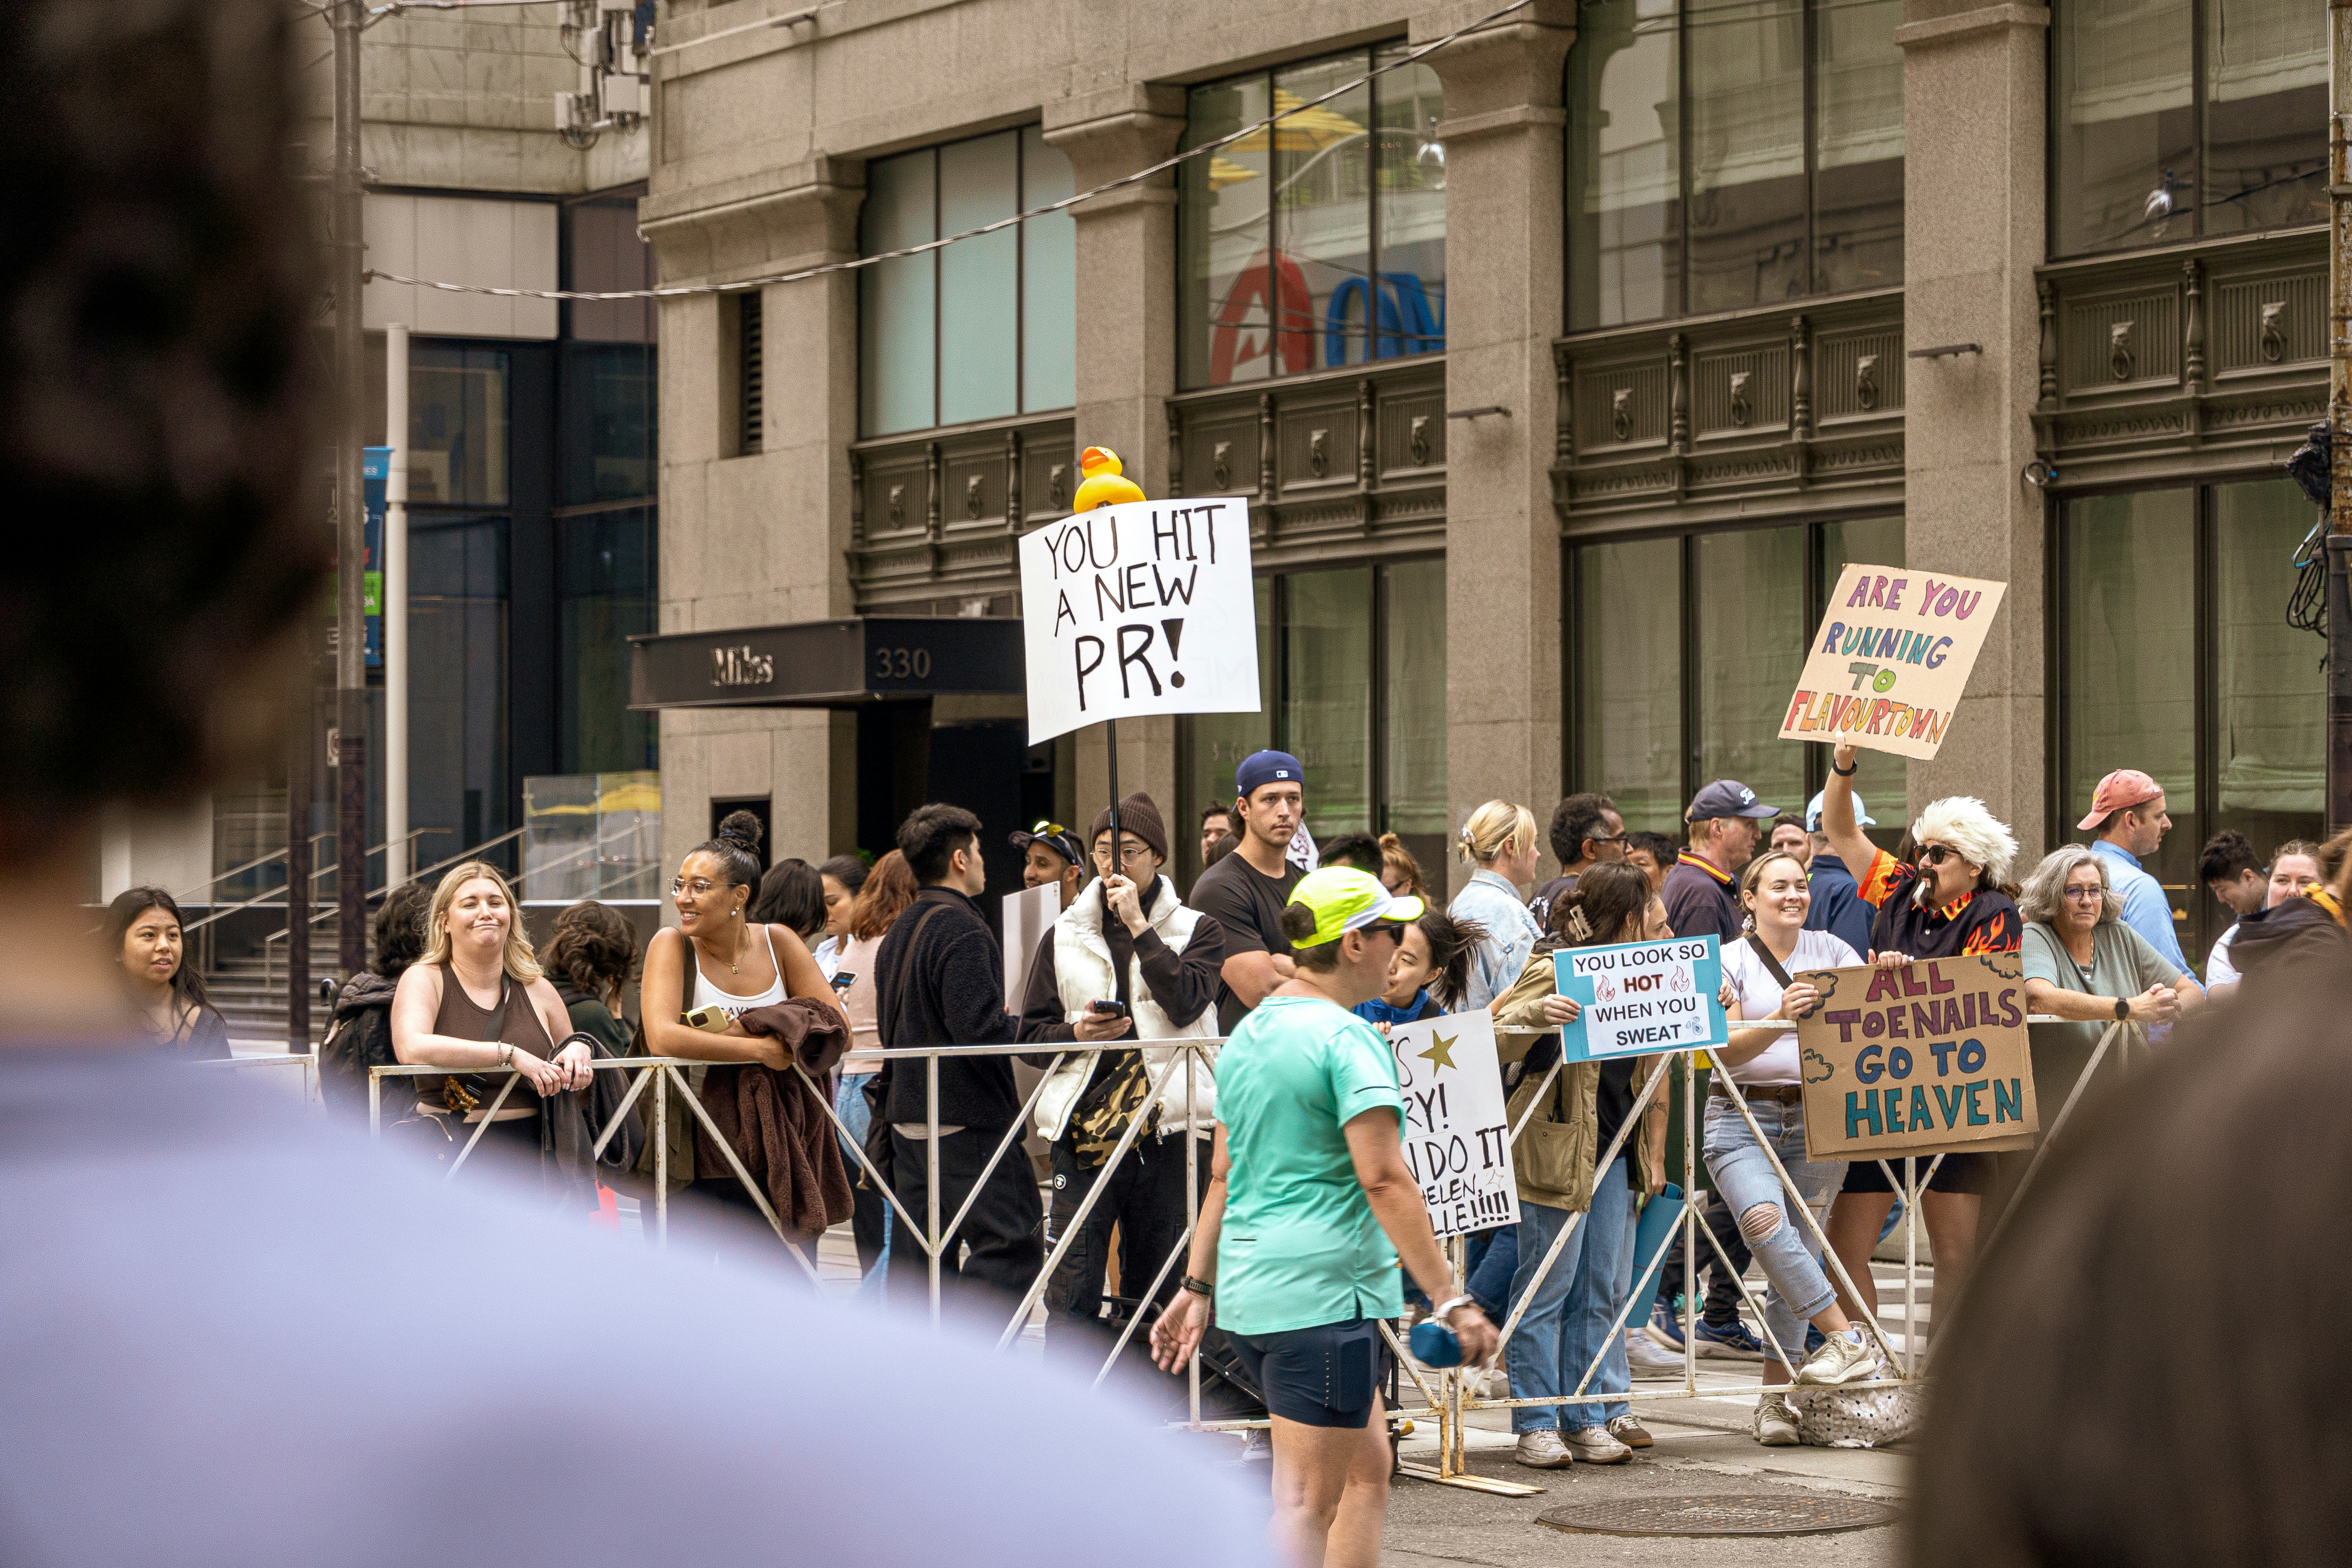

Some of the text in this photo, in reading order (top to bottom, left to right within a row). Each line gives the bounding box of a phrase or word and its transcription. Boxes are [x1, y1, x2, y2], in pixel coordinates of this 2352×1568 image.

[1045, 505, 1226, 580] YOU HIT
[1054, 588, 1076, 637] A
[1095, 562, 1198, 621] NEW
[1847, 575, 1981, 620] ARE YOU
[875, 647, 932, 679] 330
[1075, 618, 1185, 712] PR!
[1822, 622, 1953, 669] RUNNING
[1848, 662, 1896, 693] TO
[1784, 690, 1950, 744] FLAVOURTOWN
[1575, 944, 1705, 972] YOU LOOK SO
[1623, 974, 1664, 993] HOT
[1866, 962, 1955, 1002] ALL
[1595, 996, 1696, 1023] WHEN YOU
[1825, 989, 2023, 1042] TOENAILS
[1616, 1024, 1681, 1045] SWEAT
[1855, 1038, 1986, 1084] GO TO
[1846, 1078, 2023, 1139] HEAVEN
[1425, 1135, 1468, 1181] DO
[1475, 1124, 1507, 1169] IT
